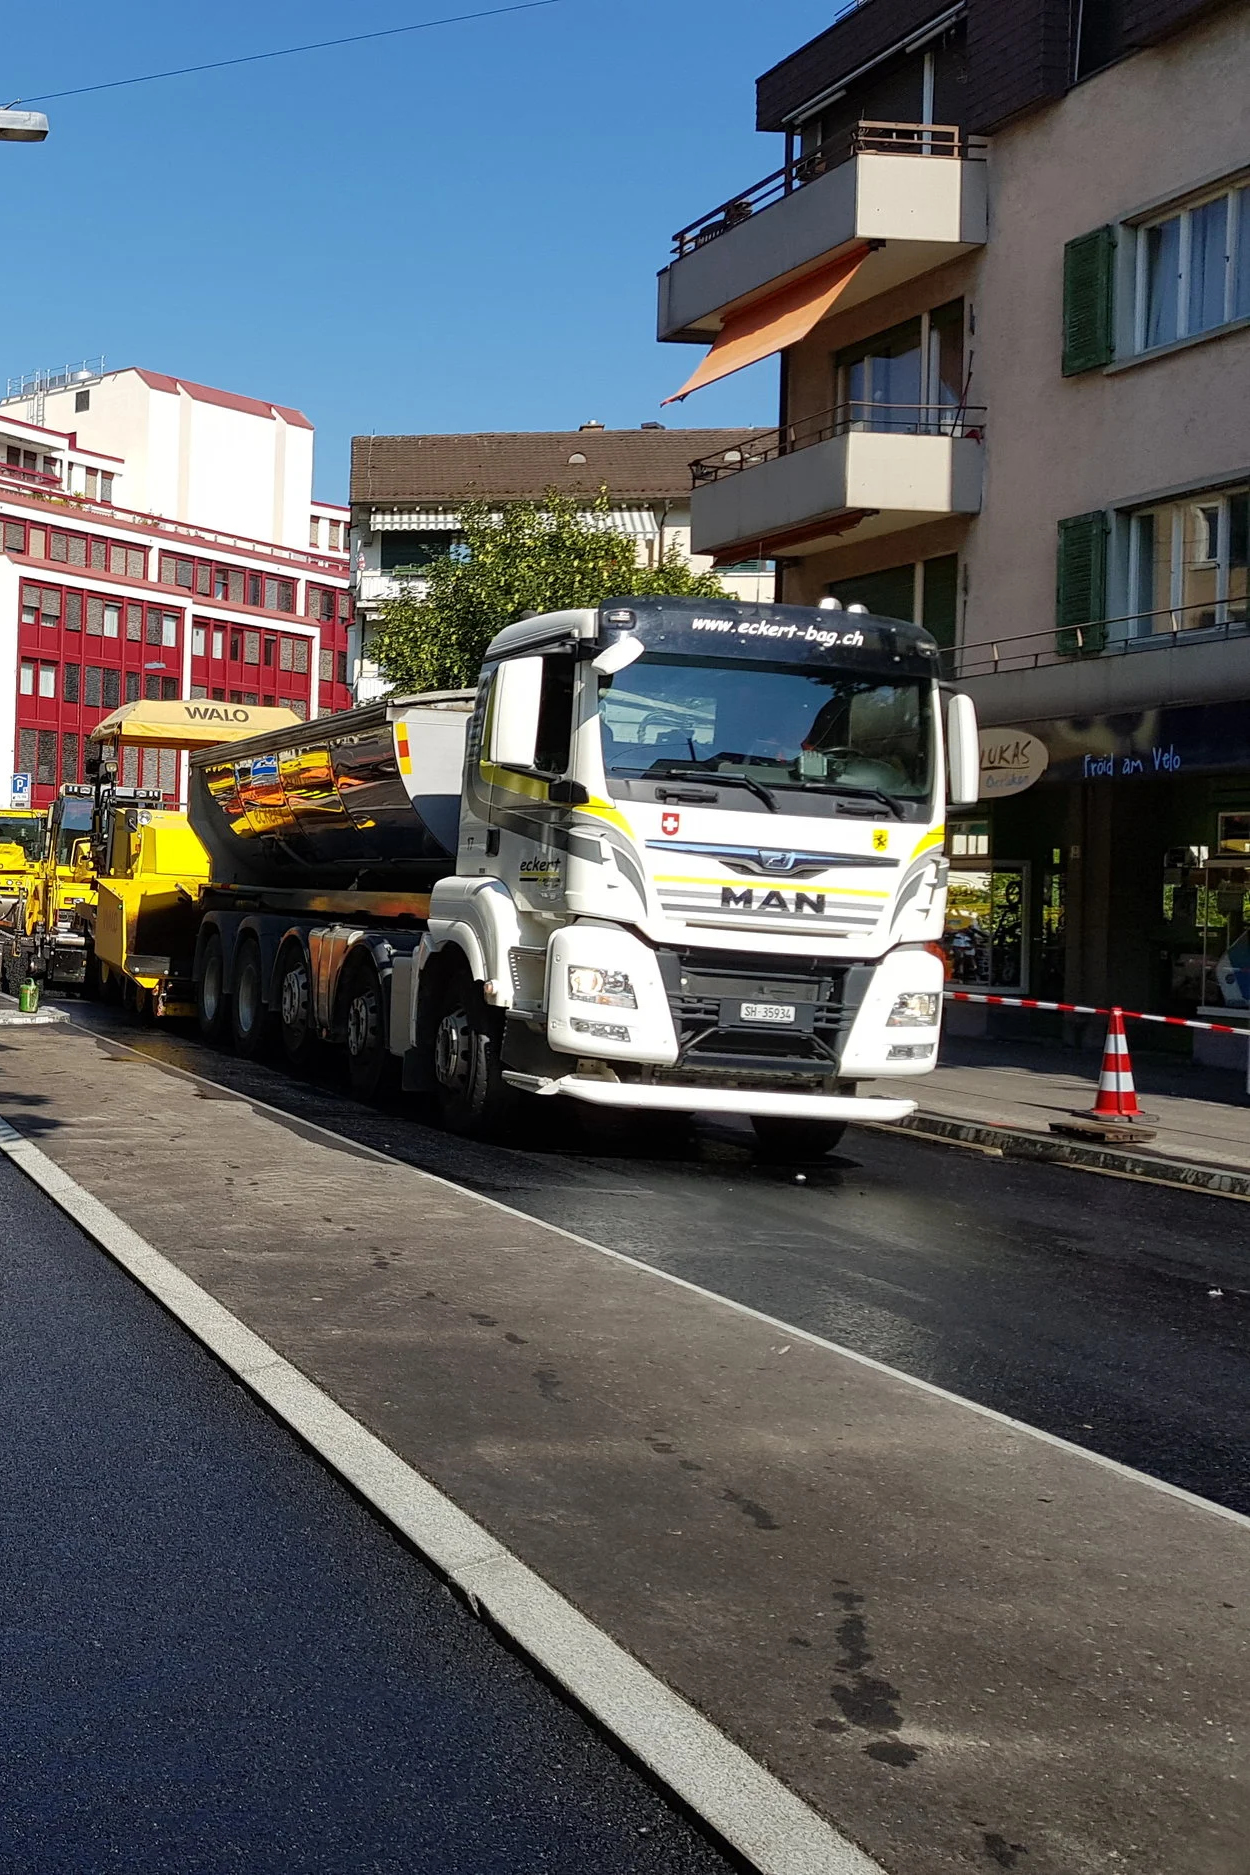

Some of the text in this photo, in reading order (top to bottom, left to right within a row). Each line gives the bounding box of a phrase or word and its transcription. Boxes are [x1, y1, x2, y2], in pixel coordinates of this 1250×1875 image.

[692, 617, 865, 647] www.eckert-bag.ch
[184, 706, 250, 723] WALO
[1122, 757, 1143, 774] am
[1152, 744, 1181, 772] Velo
[16, 779, 24, 792] P
[519, 856, 561, 872] eckert
[720, 886, 826, 915] MAN
